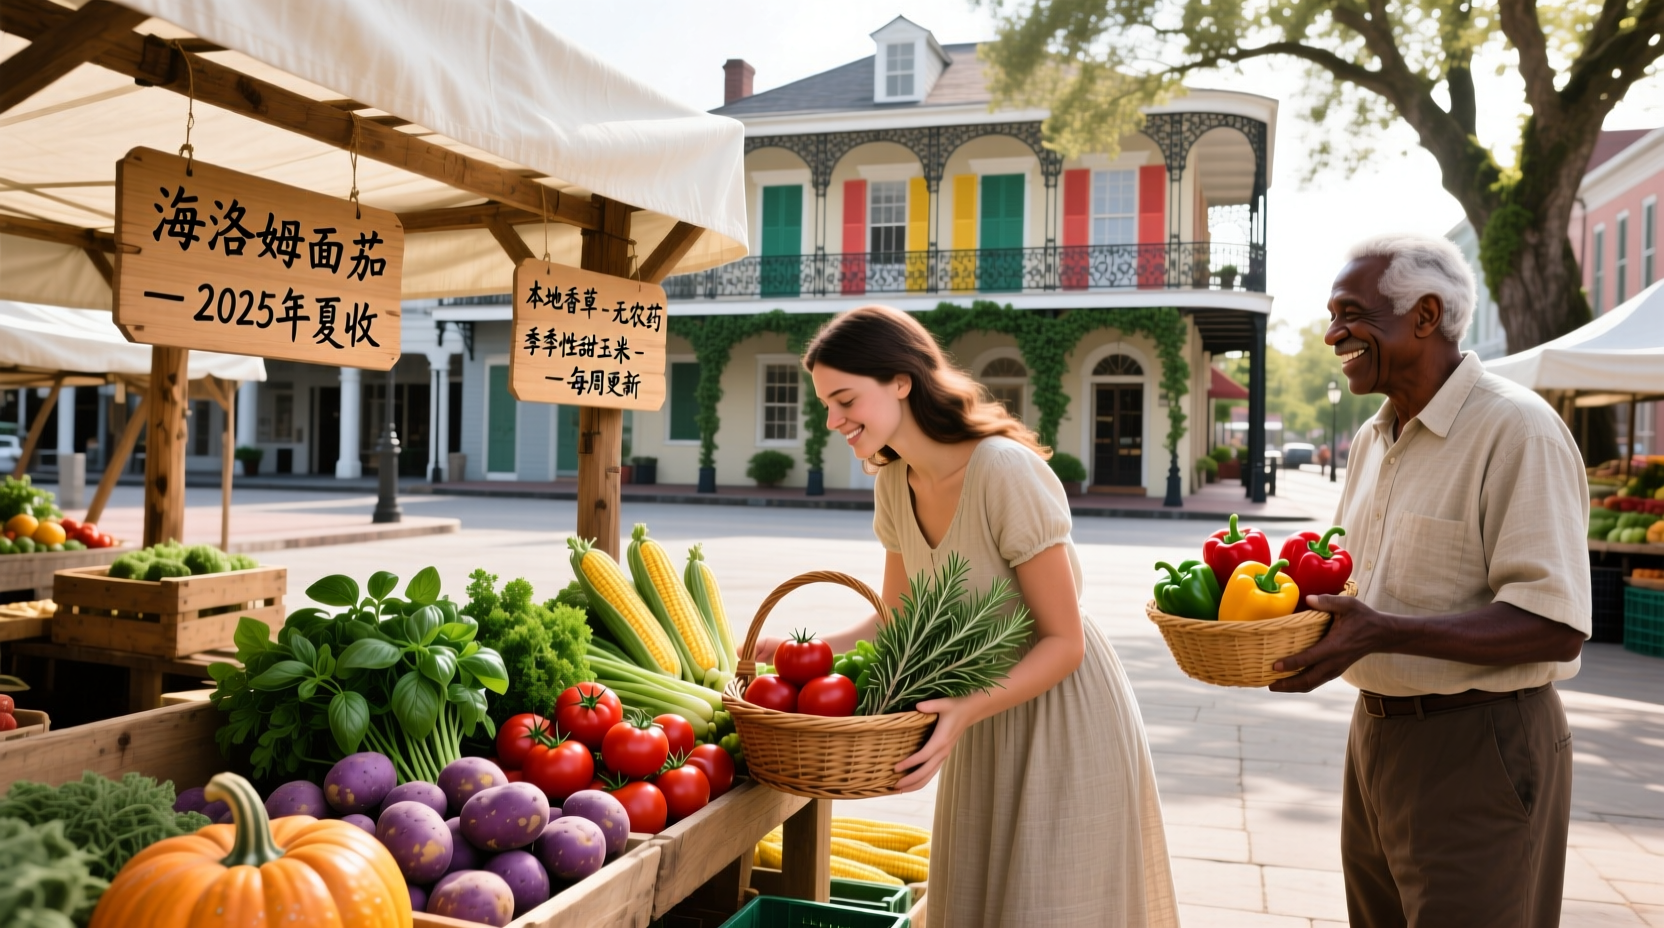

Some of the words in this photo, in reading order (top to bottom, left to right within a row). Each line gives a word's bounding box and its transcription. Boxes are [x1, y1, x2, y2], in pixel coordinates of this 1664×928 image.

[152, 184, 387, 282] 海洛姆面茄
